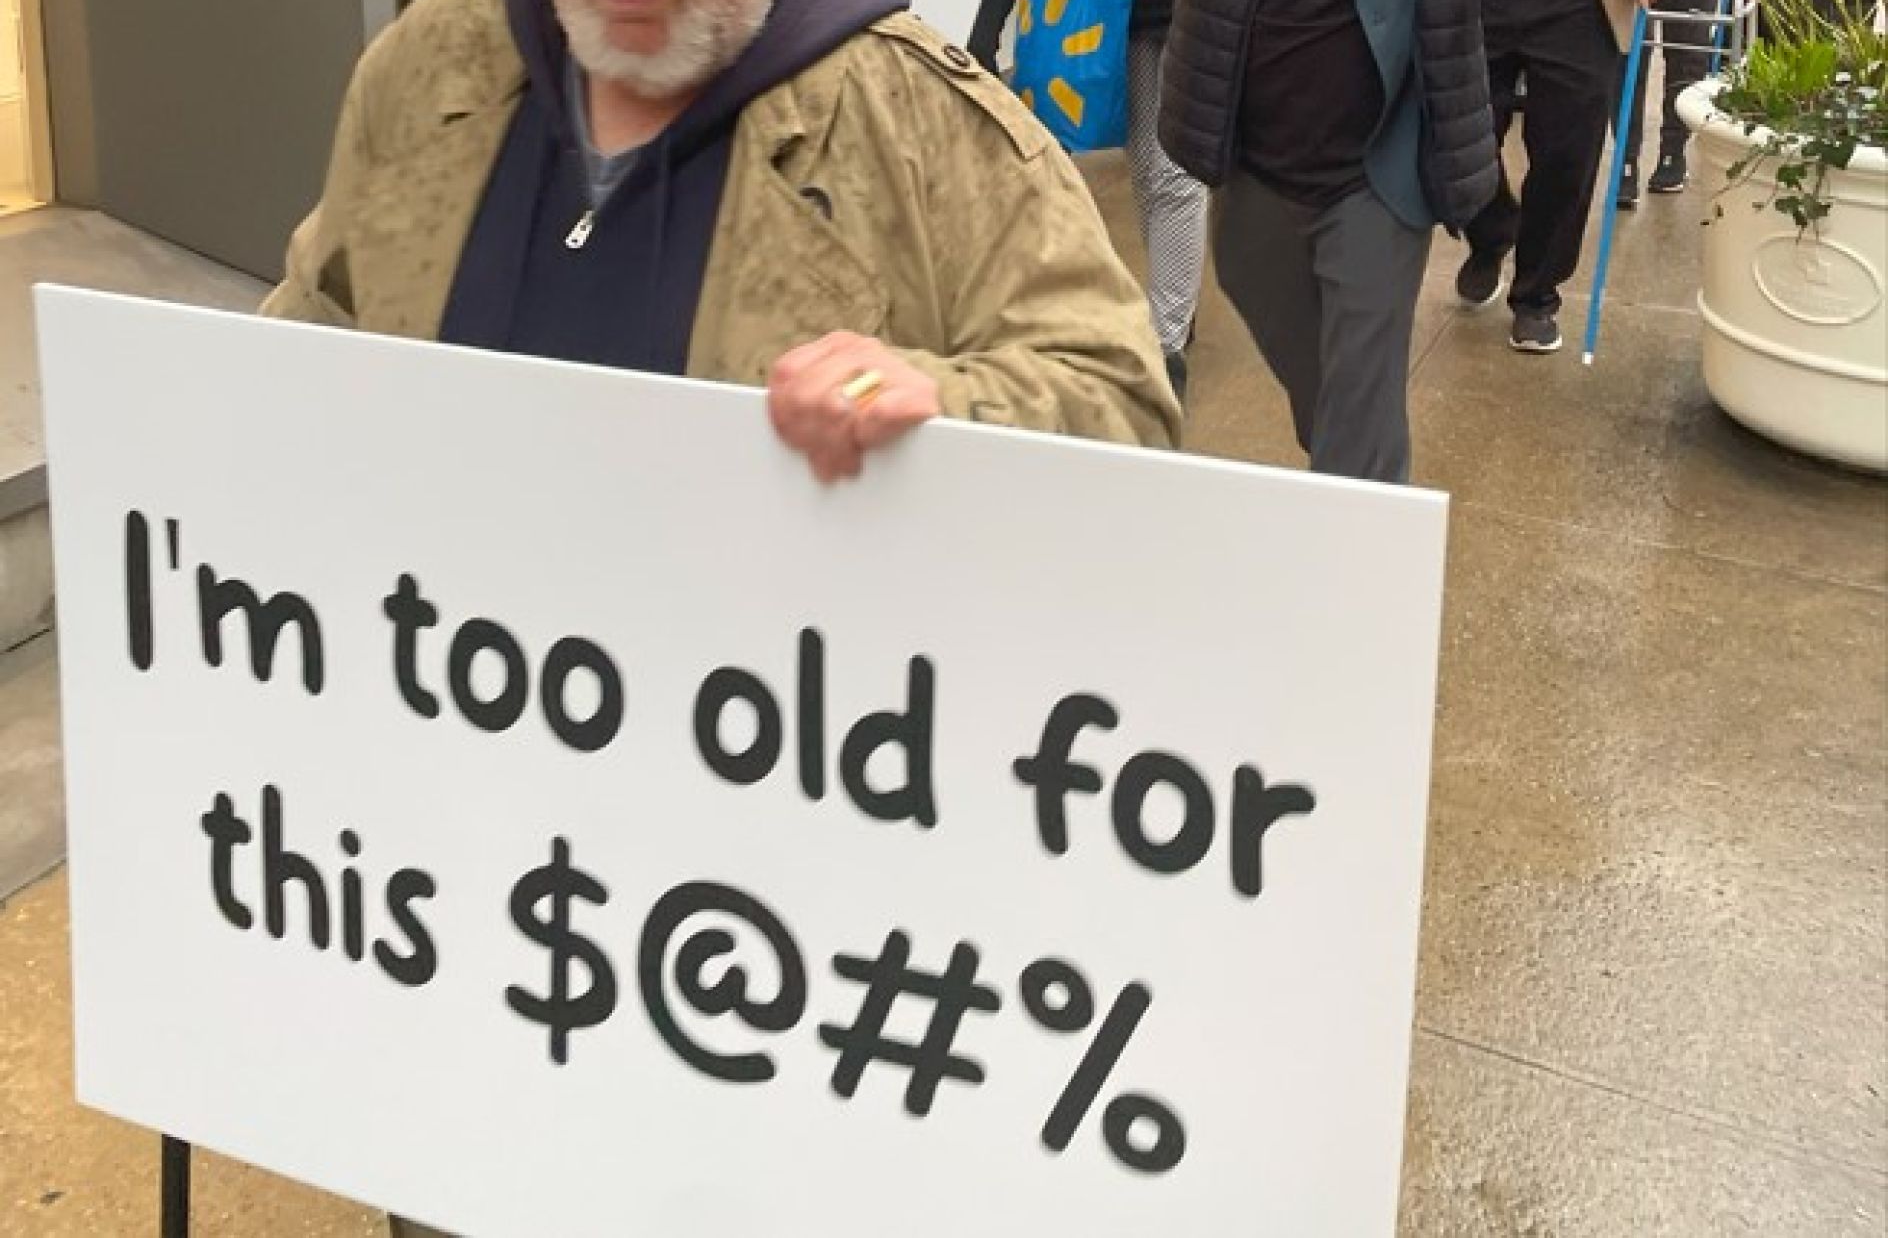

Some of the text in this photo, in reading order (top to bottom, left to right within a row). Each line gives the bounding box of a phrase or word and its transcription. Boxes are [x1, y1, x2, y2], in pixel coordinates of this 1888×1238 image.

[126, 510, 1317, 898] I'm too old for
[201, 784, 1186, 1173] this $@#%
